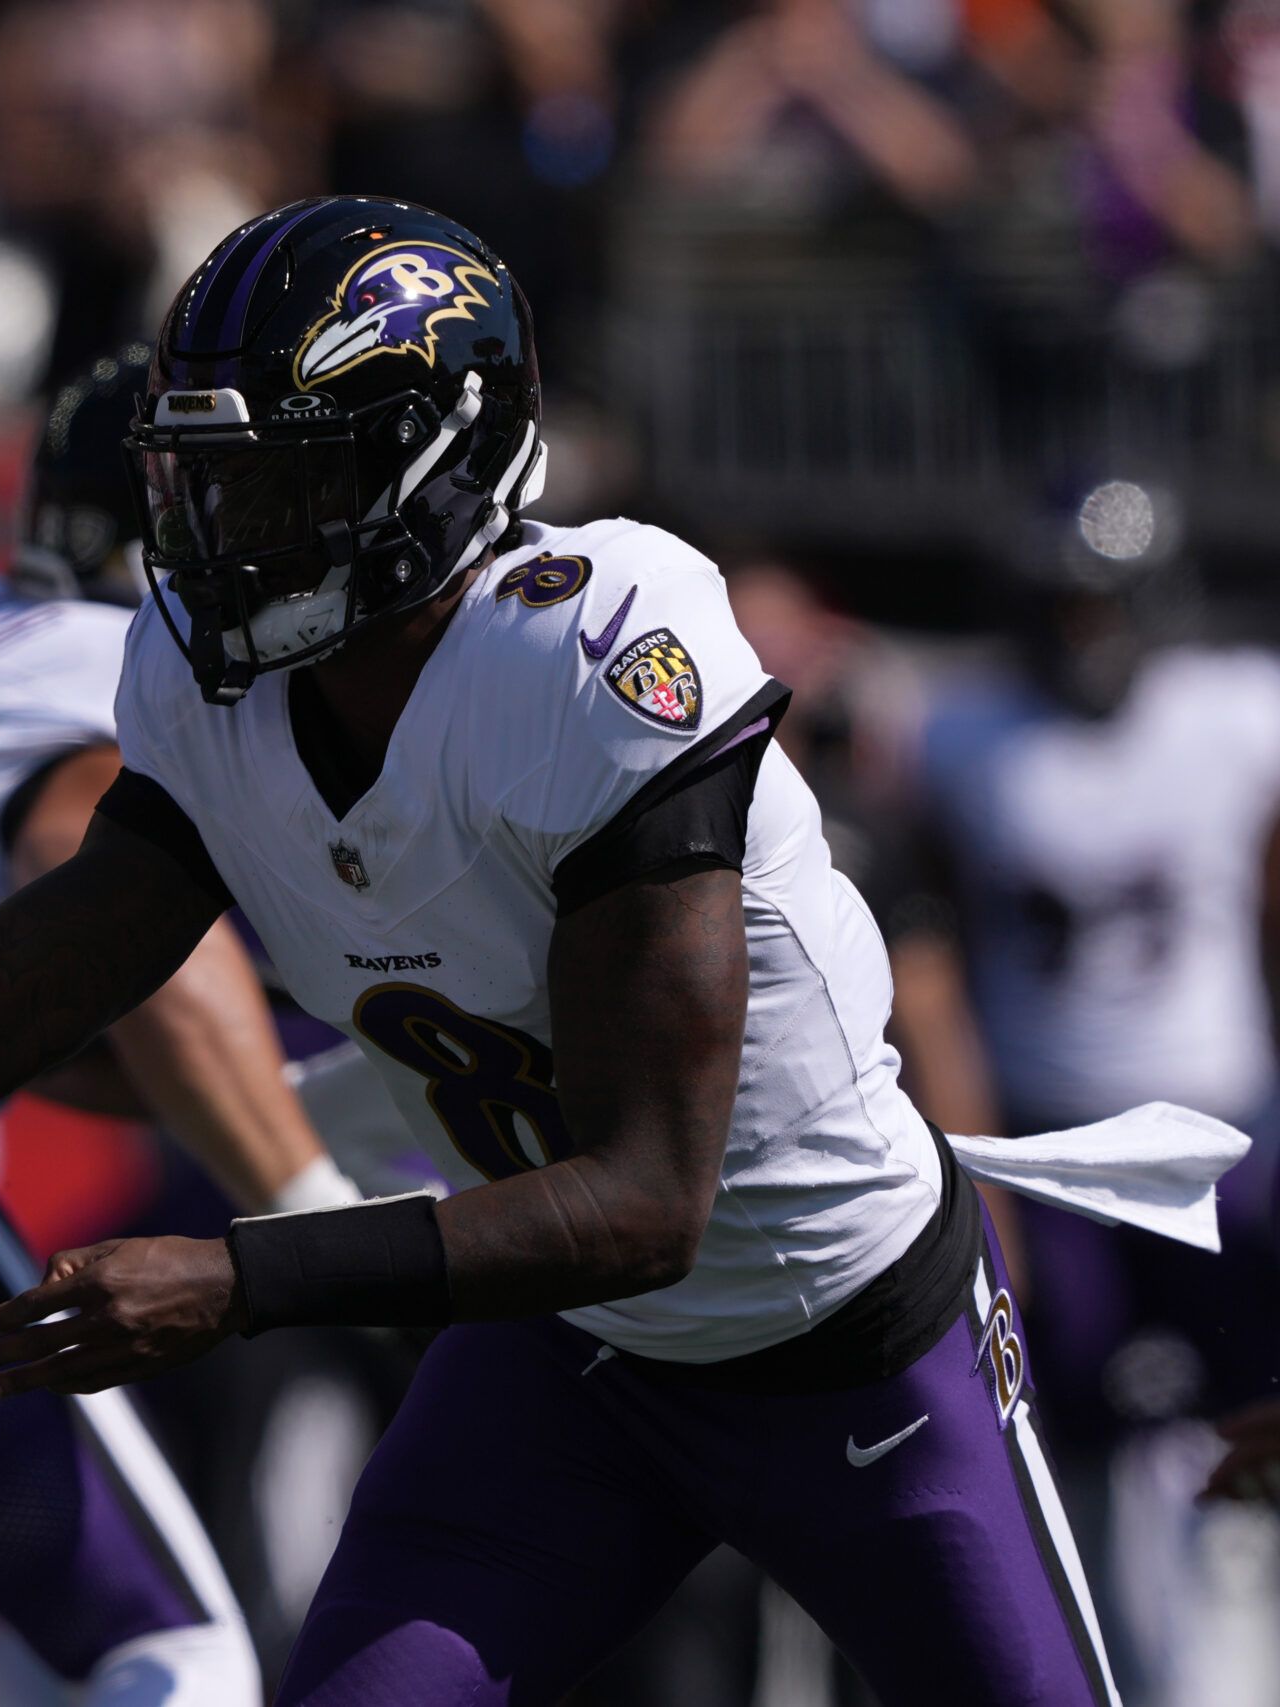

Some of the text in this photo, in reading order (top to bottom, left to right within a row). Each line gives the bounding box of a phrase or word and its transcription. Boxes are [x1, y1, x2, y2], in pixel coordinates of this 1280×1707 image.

[168, 394, 216, 412] RAVENS
[496, 551, 593, 608] 8
[610, 632, 668, 679] RAVENS
[344, 952, 441, 974] RAVENS
[352, 981, 577, 1182] 8
